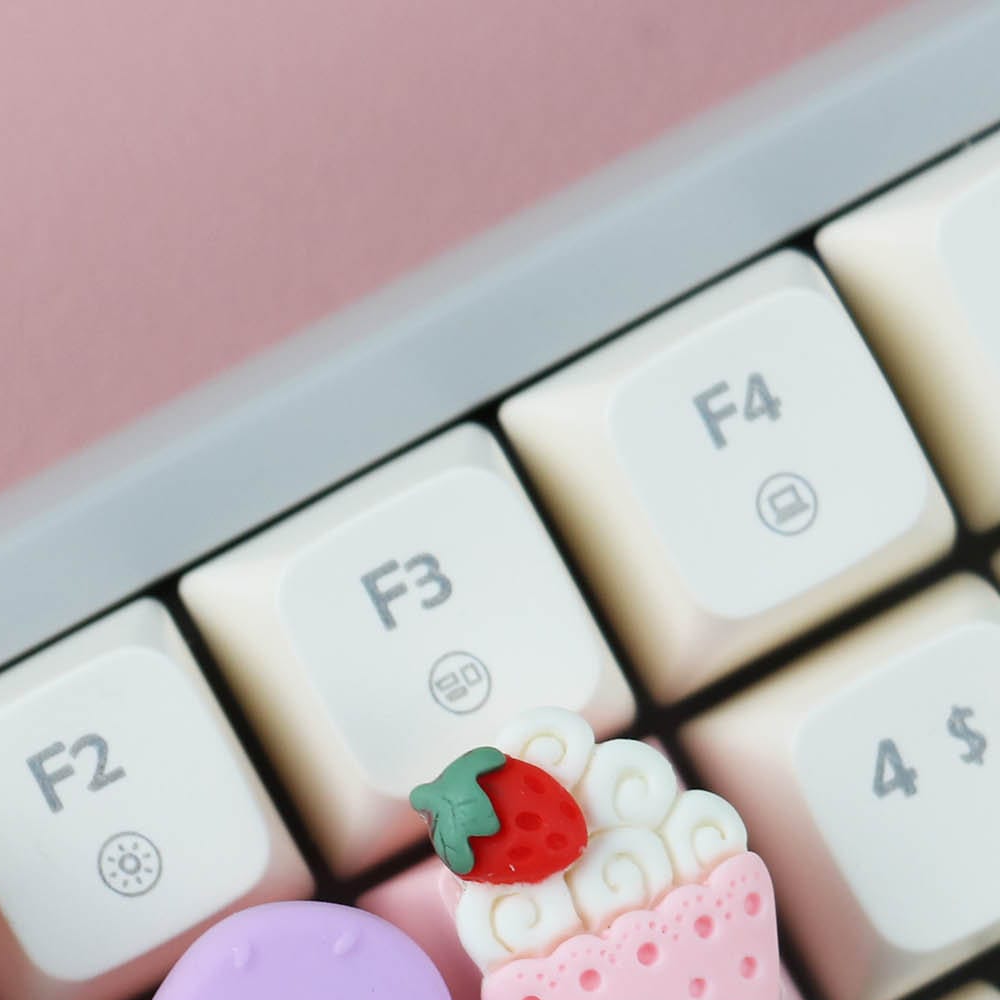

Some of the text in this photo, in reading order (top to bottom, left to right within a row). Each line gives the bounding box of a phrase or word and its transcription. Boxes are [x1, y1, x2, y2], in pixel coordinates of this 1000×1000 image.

[692, 372, 782, 451] F4
[359, 551, 453, 632] F3
[25, 733, 127, 815] F2
[871, 704, 988, 799] 4 $
